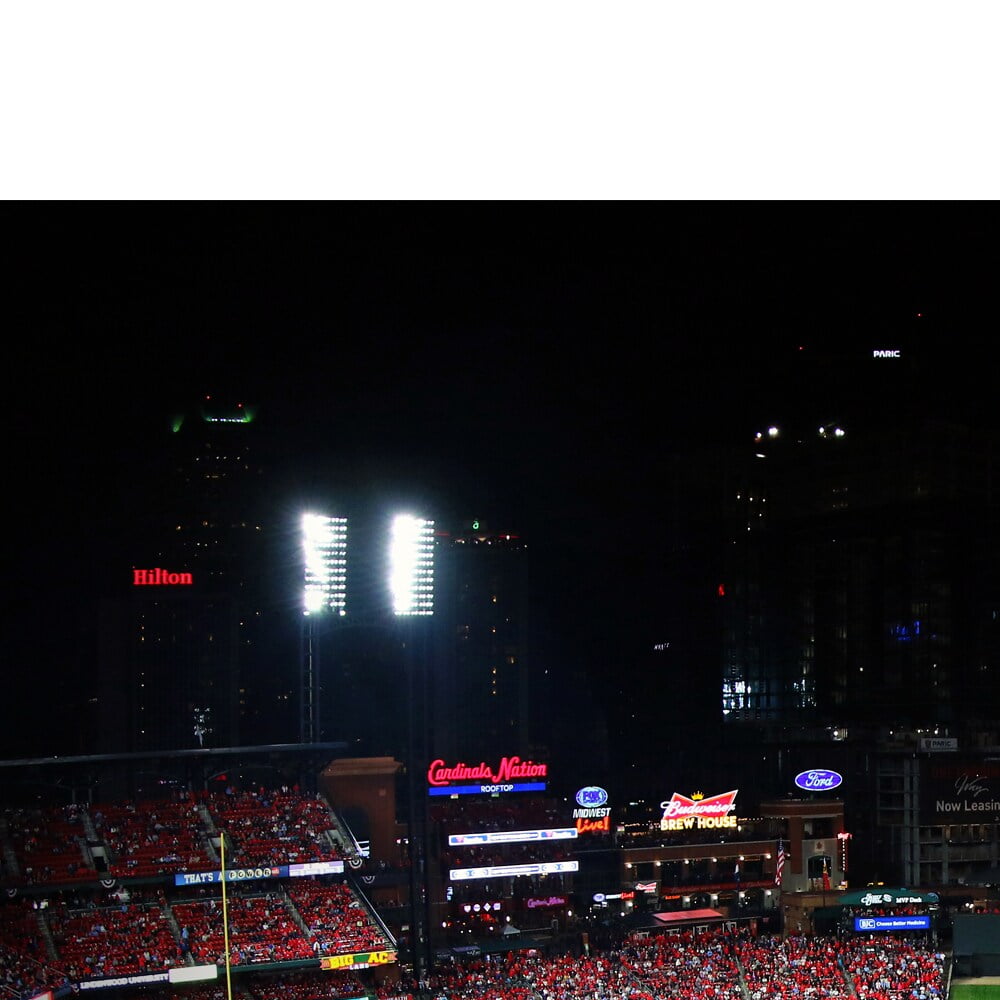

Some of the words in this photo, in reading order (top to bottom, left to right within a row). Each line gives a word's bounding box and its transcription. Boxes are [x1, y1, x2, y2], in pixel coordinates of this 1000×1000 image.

[873, 350, 900, 358] PARIC
[133, 567, 192, 585] Hilton
[428, 759, 493, 785] Cardinals
[493, 756, 548, 783] Nation
[805, 772, 834, 788] Ford
[480, 784, 514, 793] ROOFTOP
[660, 800, 736, 817] Budweiser
[936, 800, 960, 812] Now
[573, 808, 611, 819] MIDWEST
[577, 816, 610, 834] Live!
[661, 818, 694, 831] BREW
[698, 815, 737, 829] HOUSE
[183, 873, 214, 884] THAT'S
[329, 955, 354, 968] BIG
